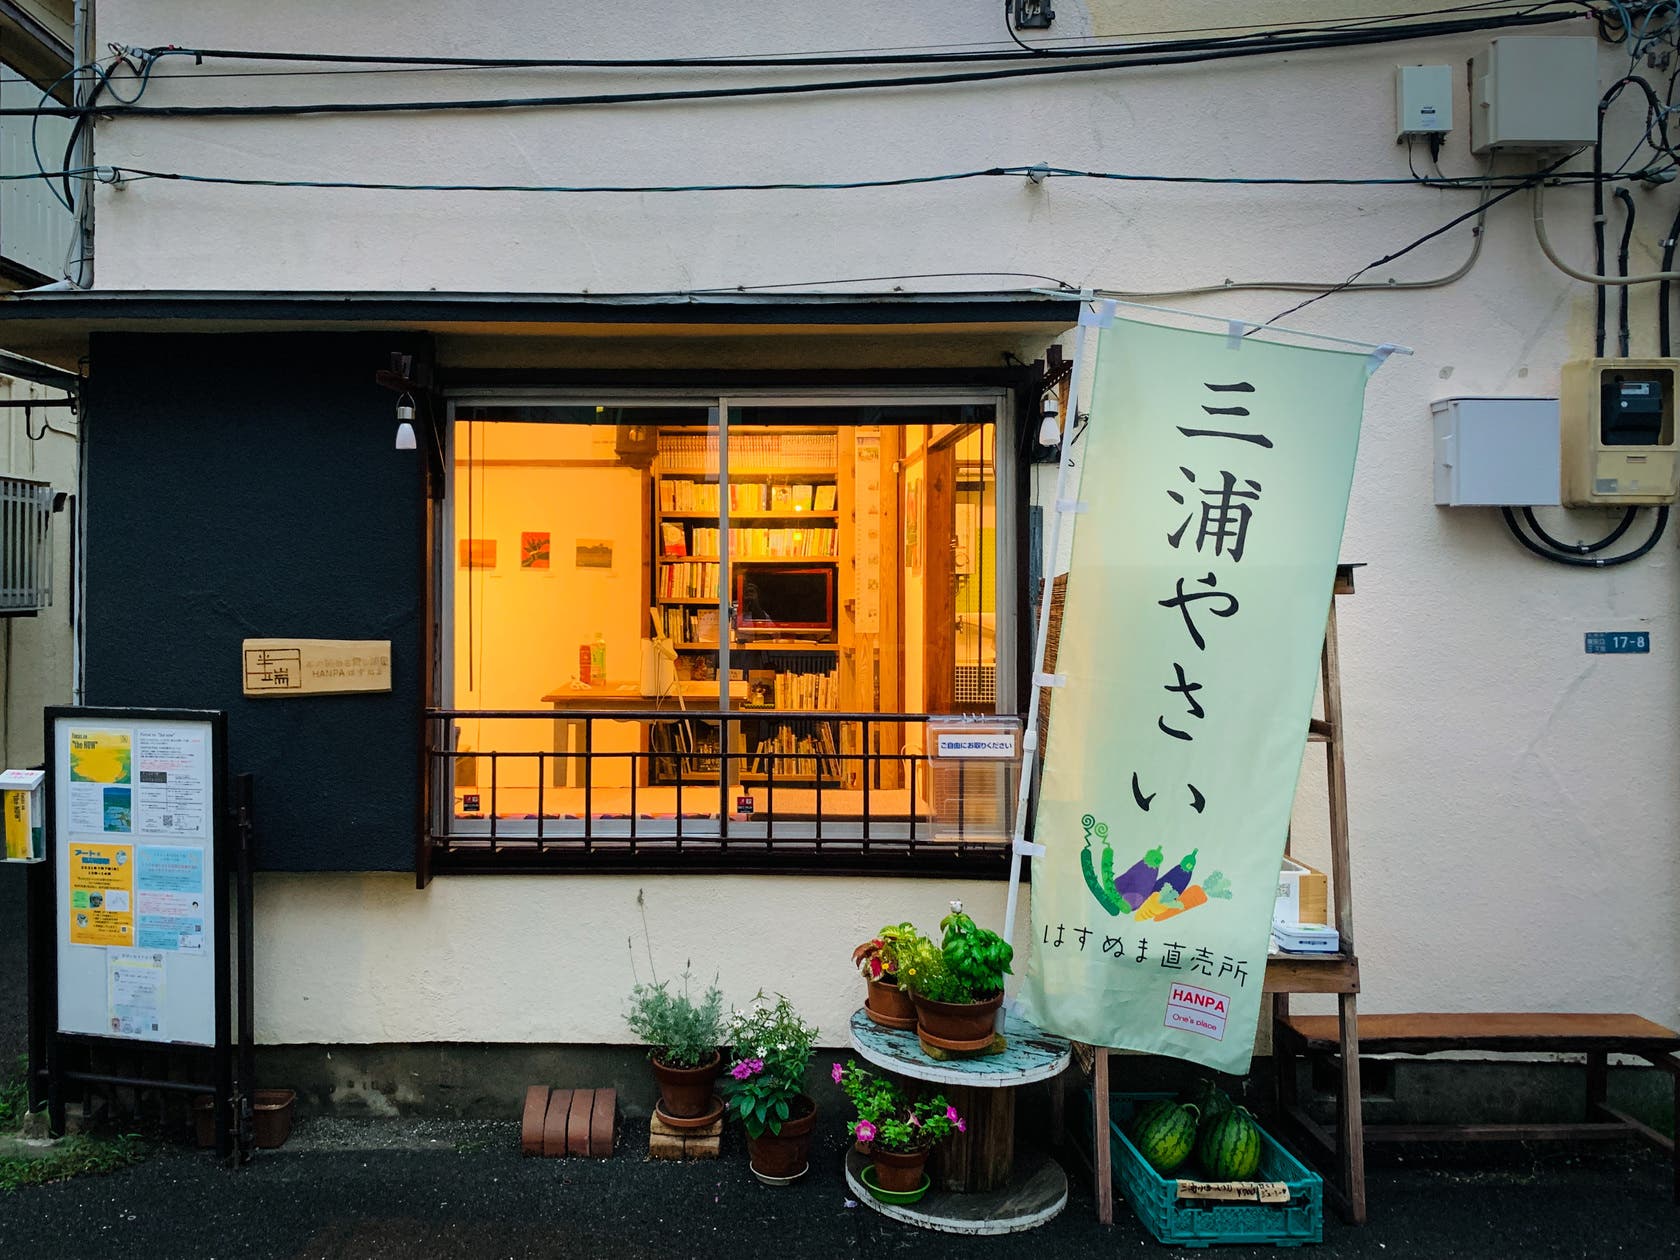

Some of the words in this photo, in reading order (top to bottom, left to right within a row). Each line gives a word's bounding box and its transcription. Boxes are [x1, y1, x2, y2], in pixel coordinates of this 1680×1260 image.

[1132, 381, 1273, 815] 三浦やさい
[1613, 636, 1645, 648] 17-8
[940, 741, 1012, 750] ご自由にお取りください
[1042, 923, 1249, 988] はすぬま直売所
[1172, 988, 1226, 1014] HANPA
[1172, 1012, 1194, 1027] One's
[1195, 1017, 1218, 1032] place
